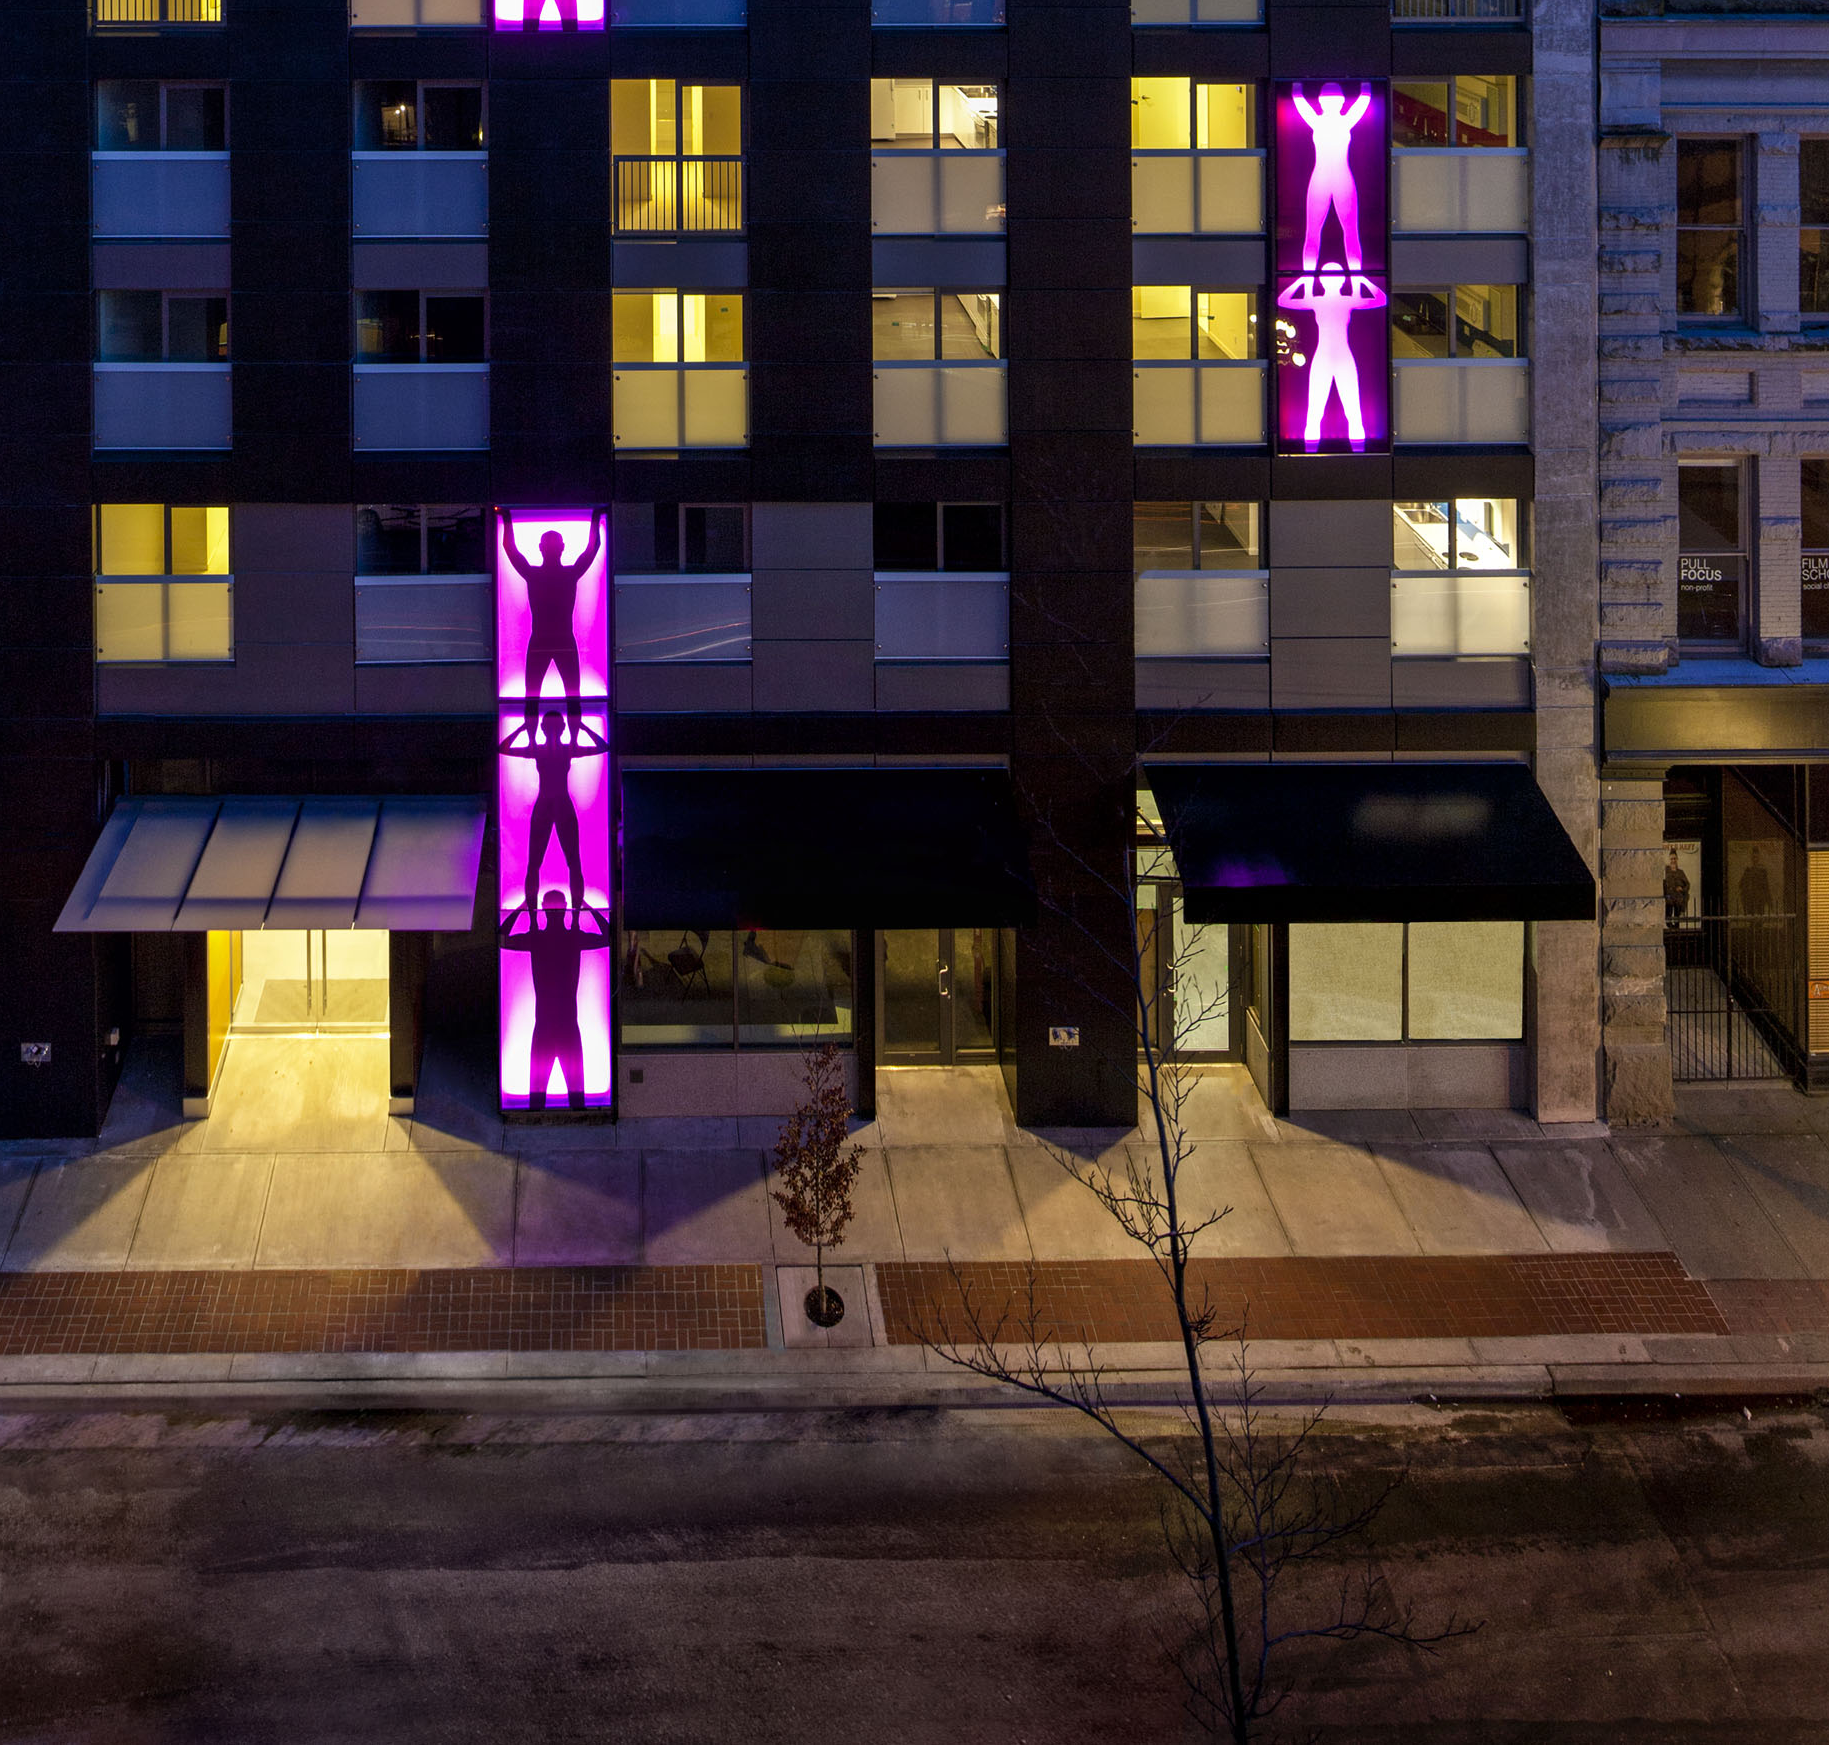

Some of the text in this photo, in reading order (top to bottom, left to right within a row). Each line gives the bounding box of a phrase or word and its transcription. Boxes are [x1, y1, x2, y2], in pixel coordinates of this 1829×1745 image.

[1681, 558, 1711, 570] PULL
[1802, 558, 1828, 569] FILM
[1681, 569, 1722, 581] FOCUS
[1680, 583, 1713, 592] non-profit
[1803, 583, 1821, 591] social
